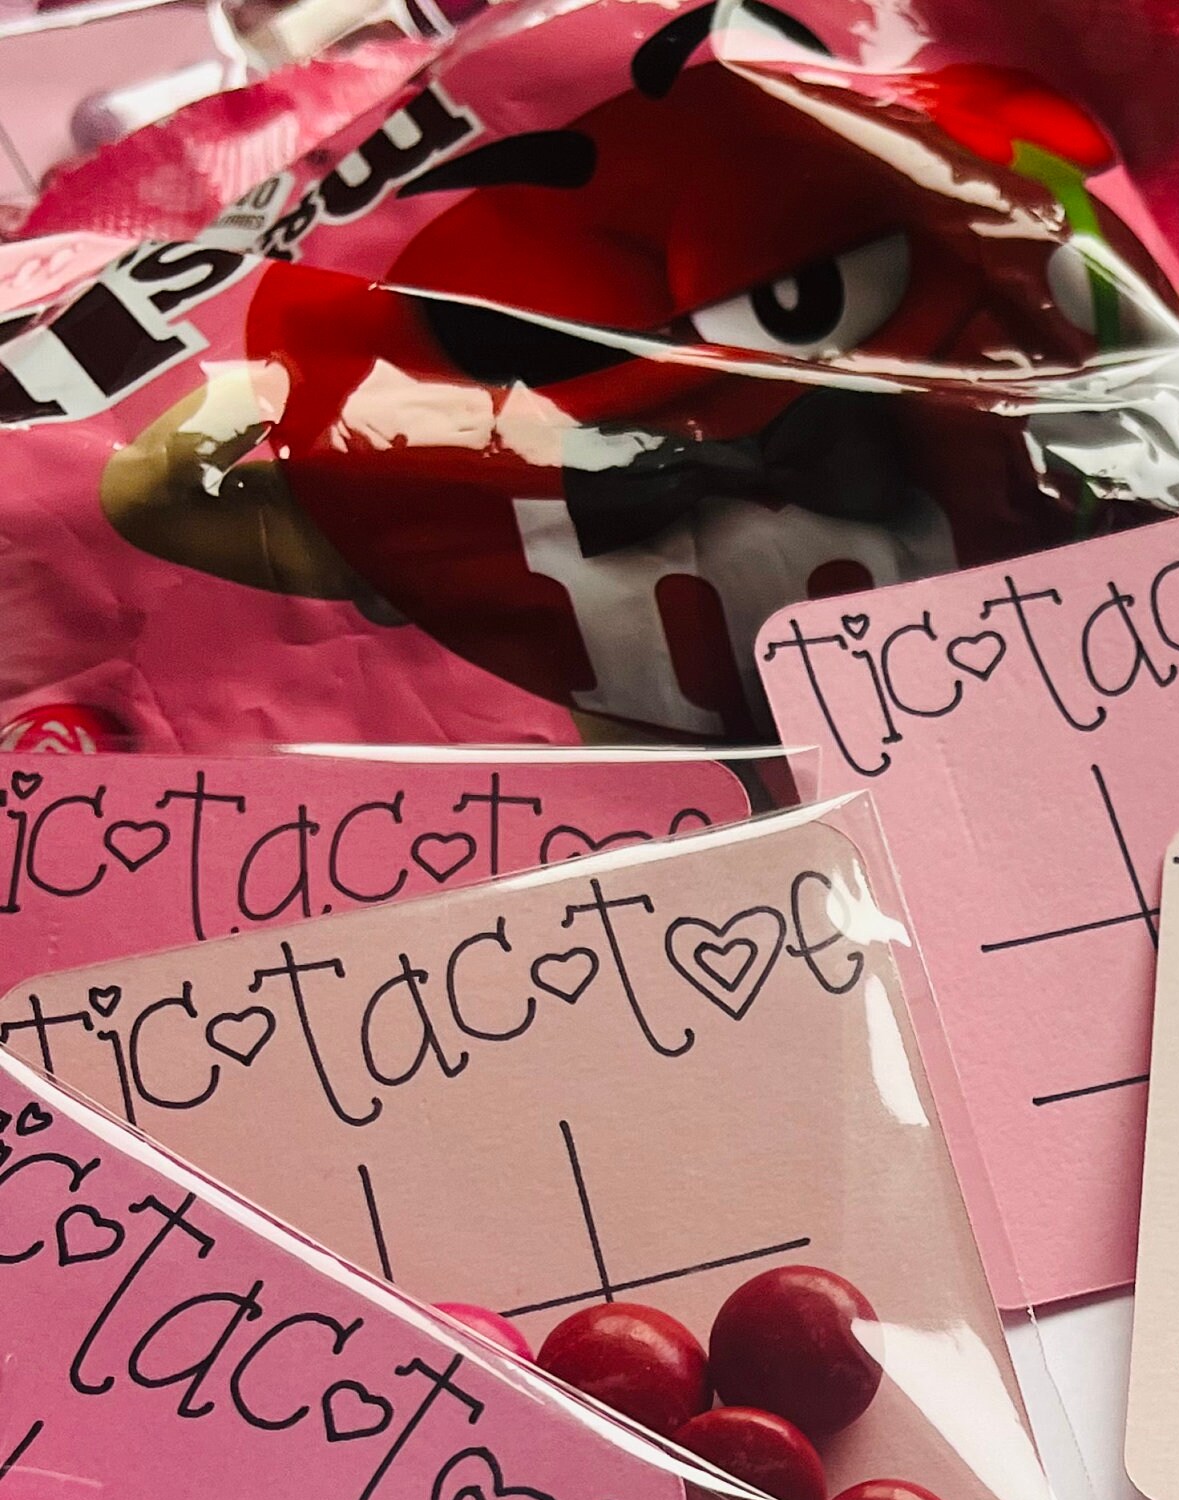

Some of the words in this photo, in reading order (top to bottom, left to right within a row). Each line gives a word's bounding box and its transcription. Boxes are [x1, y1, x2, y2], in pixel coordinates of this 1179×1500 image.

[764, 610, 963, 777] tic
[0, 771, 107, 913] ic
[156, 770, 408, 941] tac
[249, 917, 537, 1127] tac
[70, 1192, 363, 1430] tac
